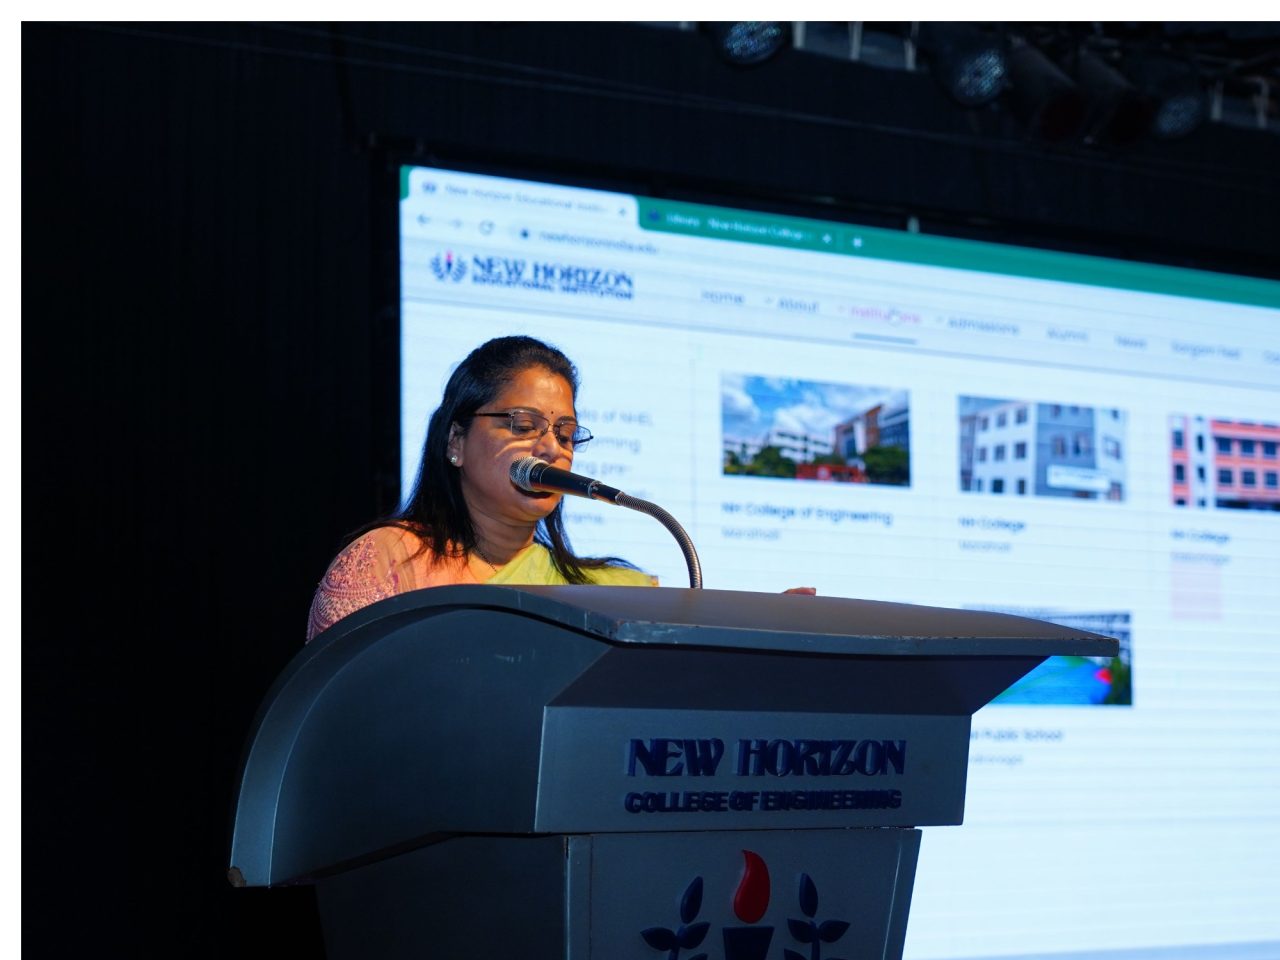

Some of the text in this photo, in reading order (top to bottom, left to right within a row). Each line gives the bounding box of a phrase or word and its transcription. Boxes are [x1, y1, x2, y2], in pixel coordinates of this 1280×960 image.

[473, 254, 633, 288] NEW HORIZON
[625, 738, 907, 777] NEW HORIZON
[624, 789, 902, 814] COLLEGE OF ENGINEERING
